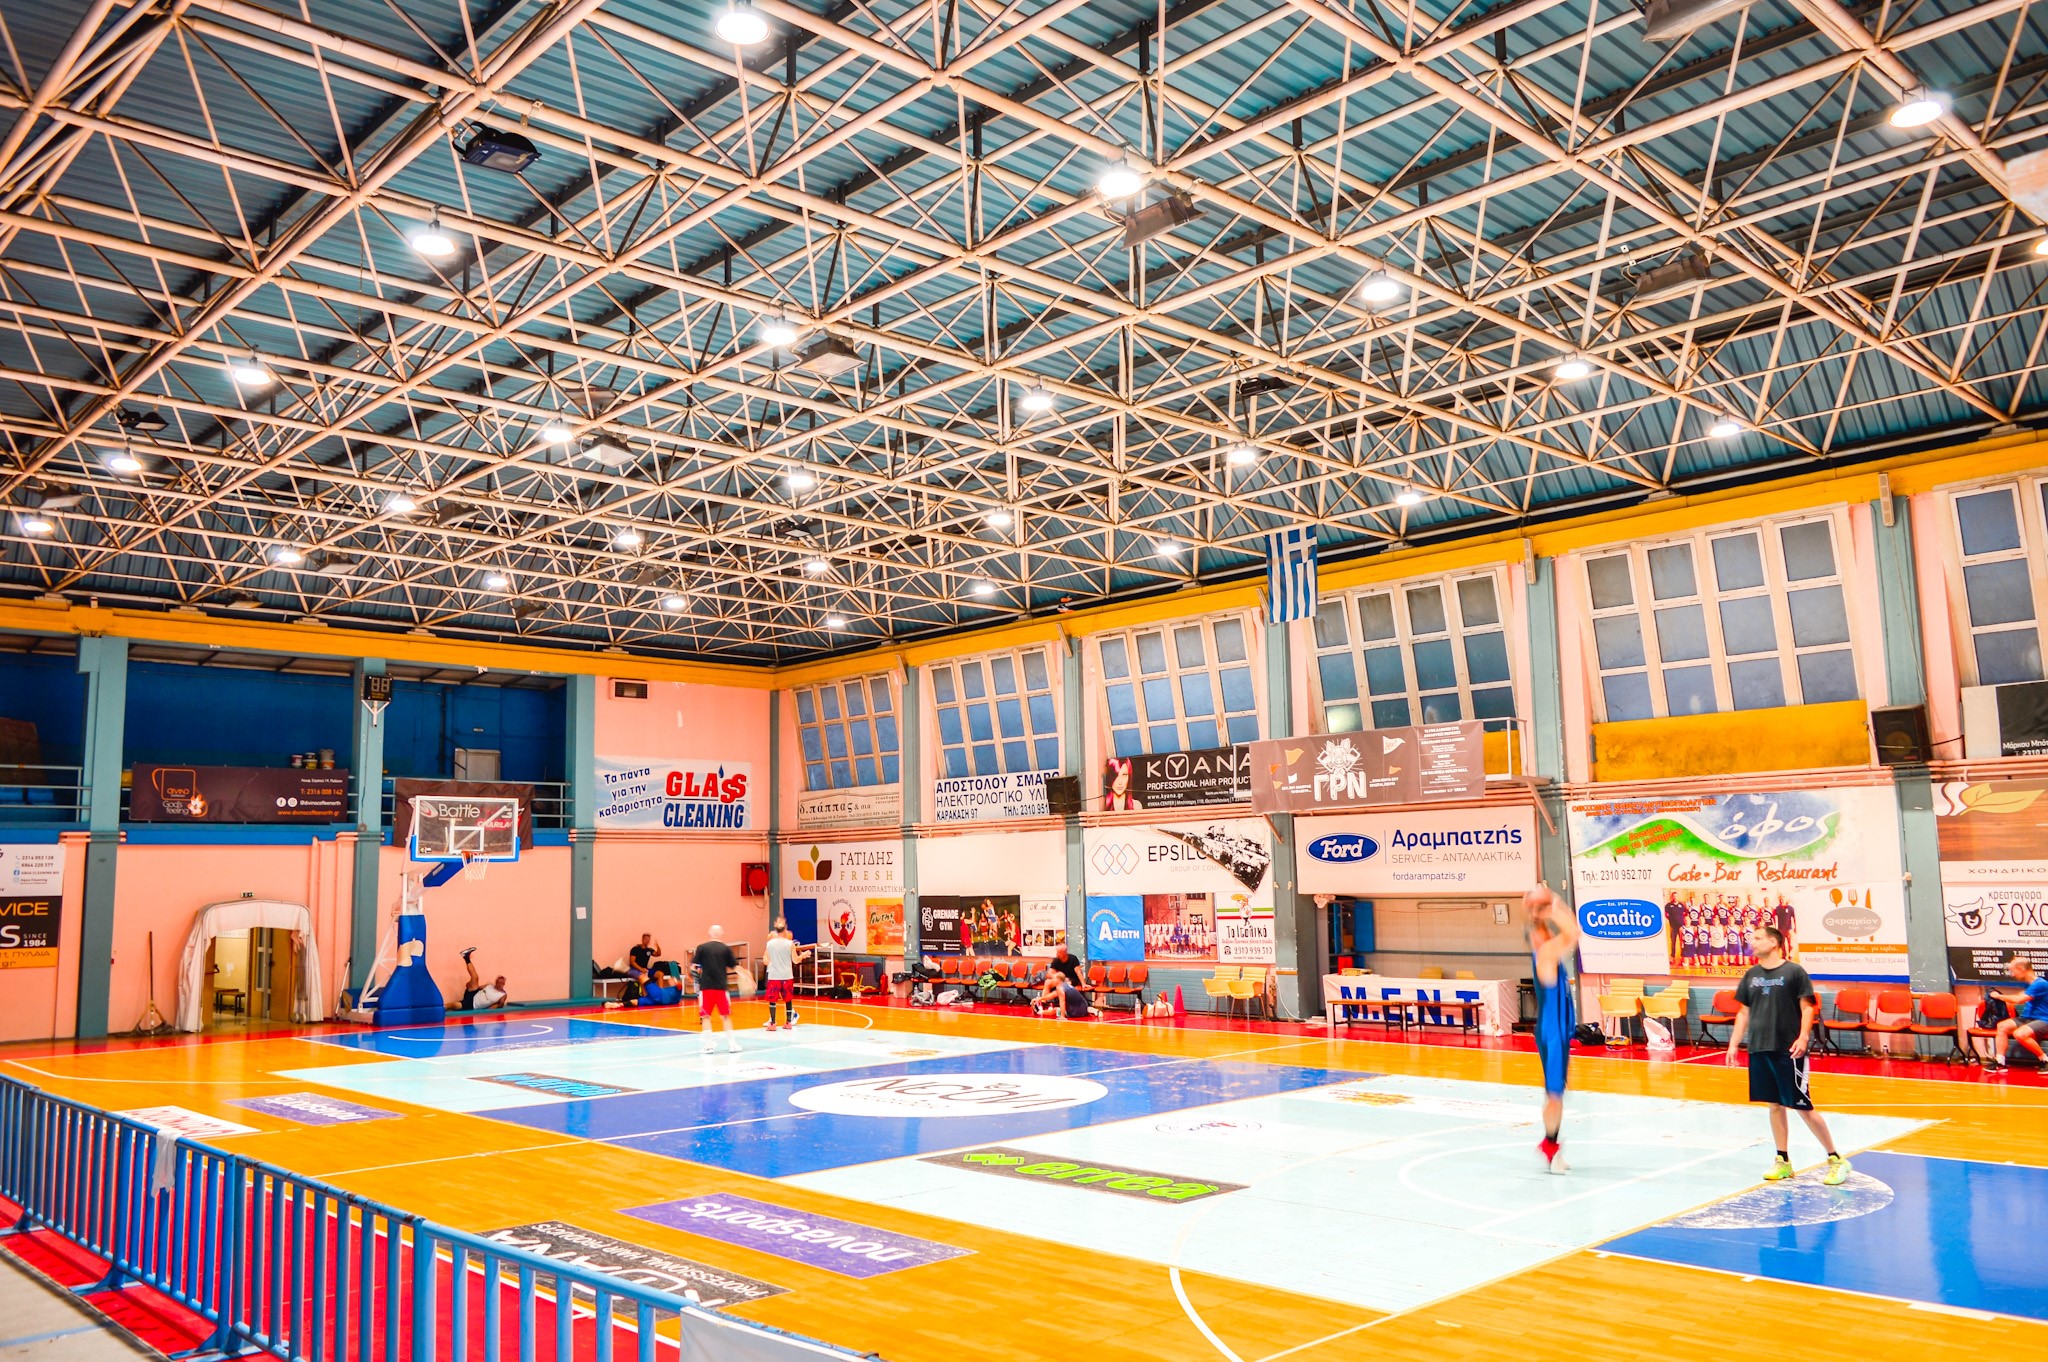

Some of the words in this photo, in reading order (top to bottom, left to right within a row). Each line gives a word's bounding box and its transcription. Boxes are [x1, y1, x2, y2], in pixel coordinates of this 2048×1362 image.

[2002, 741, 2030, 750] Μάρκου
[1146, 752, 1251, 778] KYANA
[604, 773, 617, 784] Τα
[620, 767, 650, 781] πάντα
[611, 789, 627, 801] για
[630, 783, 647, 796] την
[665, 770, 748, 804] GLASS
[936, 776, 1008, 793] ΑΠΟΣΤΟΛΟΥ
[1146, 779, 1198, 791] PROFESSIONAL
[1200, 778, 1217, 787] HAIR
[598, 795, 663, 818] καθαριότητα
[936, 790, 1023, 808] ΗΛΕΚΤΡΟΛΟΓΙΚΟ
[438, 803, 480, 818] Battle
[663, 802, 745, 828] CLEANING
[936, 808, 970, 820] ΚΑΡΑΚΑΣΗ
[970, 808, 978, 819] 97
[1004, 806, 1019, 817] ΤΗΛ:
[1020, 804, 1036, 815] 2310
[1391, 825, 1522, 851] Αραμπατζής
[1320, 838, 1364, 860] Ford
[1391, 853, 1433, 864] SERVICE
[1442, 851, 1522, 863] ΑΝΤΑΛΛΑΚΤΙΚΑ
[840, 852, 893, 866] ΓΑΤΙΔΗΣ
[840, 870, 893, 880] FRESH
[1392, 871, 1466, 881] fordarampatzis.gr
[1581, 870, 1598, 883] Τηλ:
[1600, 870, 1619, 881] 2310
[1621, 869, 1652, 880] 952.707
[1668, 863, 1702, 882] Cafe
[1712, 860, 1742, 883] Bar
[1756, 860, 1838, 882] Restaurant
[933, 909, 959, 920] GRENADE
[1586, 908, 1652, 928] Condito
[939, 921, 953, 931] GYM
[1226, 926, 1235, 938] Το
[23, 939, 46, 947] 1984
[530, 1222, 617, 1251] PRODUCTS
[680, 1200, 914, 1264] novasports
[604, 1242, 648, 1262] HAIR
[643, 1254, 769, 1299] PROFESSIONAL
